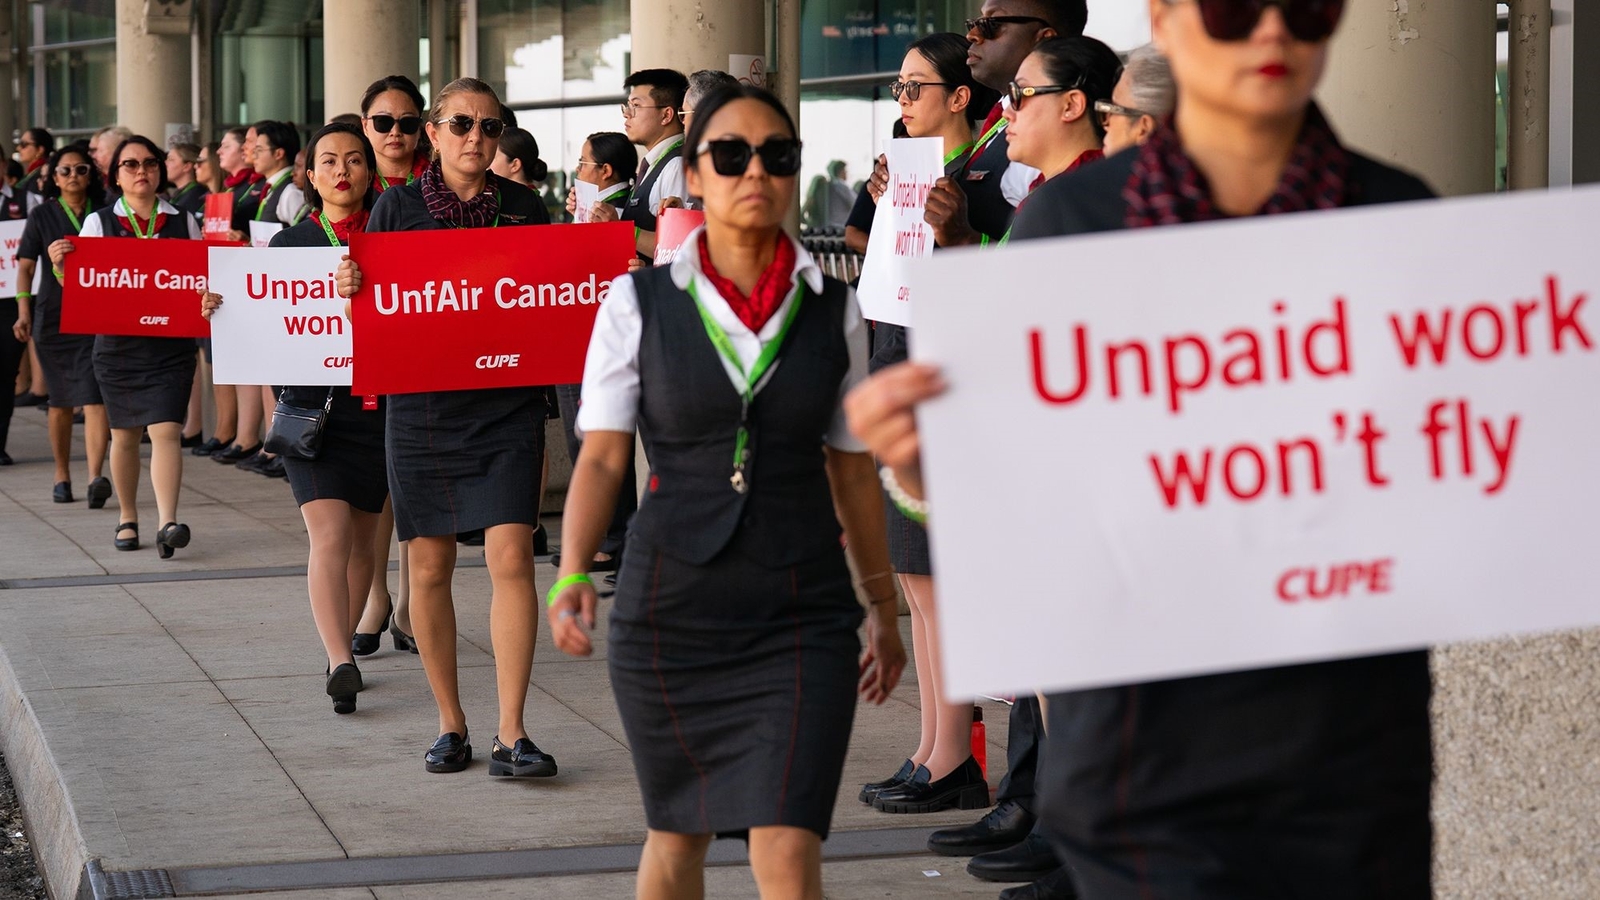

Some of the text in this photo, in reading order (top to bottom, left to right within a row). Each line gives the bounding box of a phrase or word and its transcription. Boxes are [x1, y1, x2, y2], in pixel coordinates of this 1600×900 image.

[893, 173, 917, 216] Unpaid
[895, 222, 916, 257] won't
[78, 267, 208, 290] UnfAir Cana
[374, 280, 483, 315] UnfAir
[139, 315, 170, 326] CUPE
[475, 353, 520, 369] CUPE
[1027, 275, 1594, 414] Unpaid work
[1149, 399, 1520, 509] won't fly
[1276, 558, 1394, 603] CUPE
